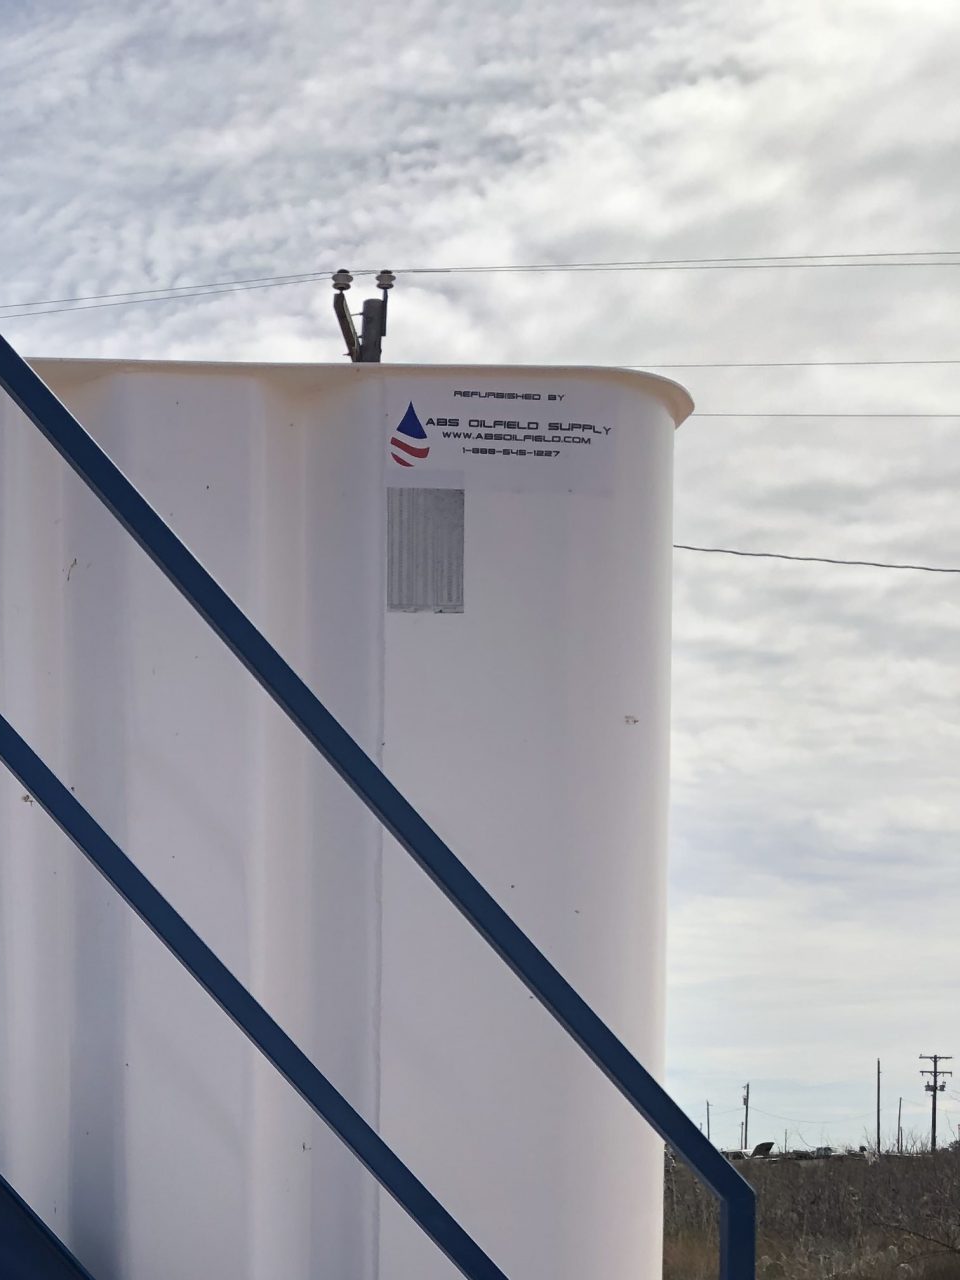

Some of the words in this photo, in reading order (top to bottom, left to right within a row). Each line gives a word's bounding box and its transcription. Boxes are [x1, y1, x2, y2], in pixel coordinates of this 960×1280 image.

[453, 390, 541, 401] REFURBISHED
[547, 394, 565, 402] BY
[425, 417, 460, 427] ABS
[468, 419, 539, 431] OILFIELD
[547, 422, 612, 436] SUPPLY
[442, 431, 592, 445] WWW.ABSOILFIELD.COM
